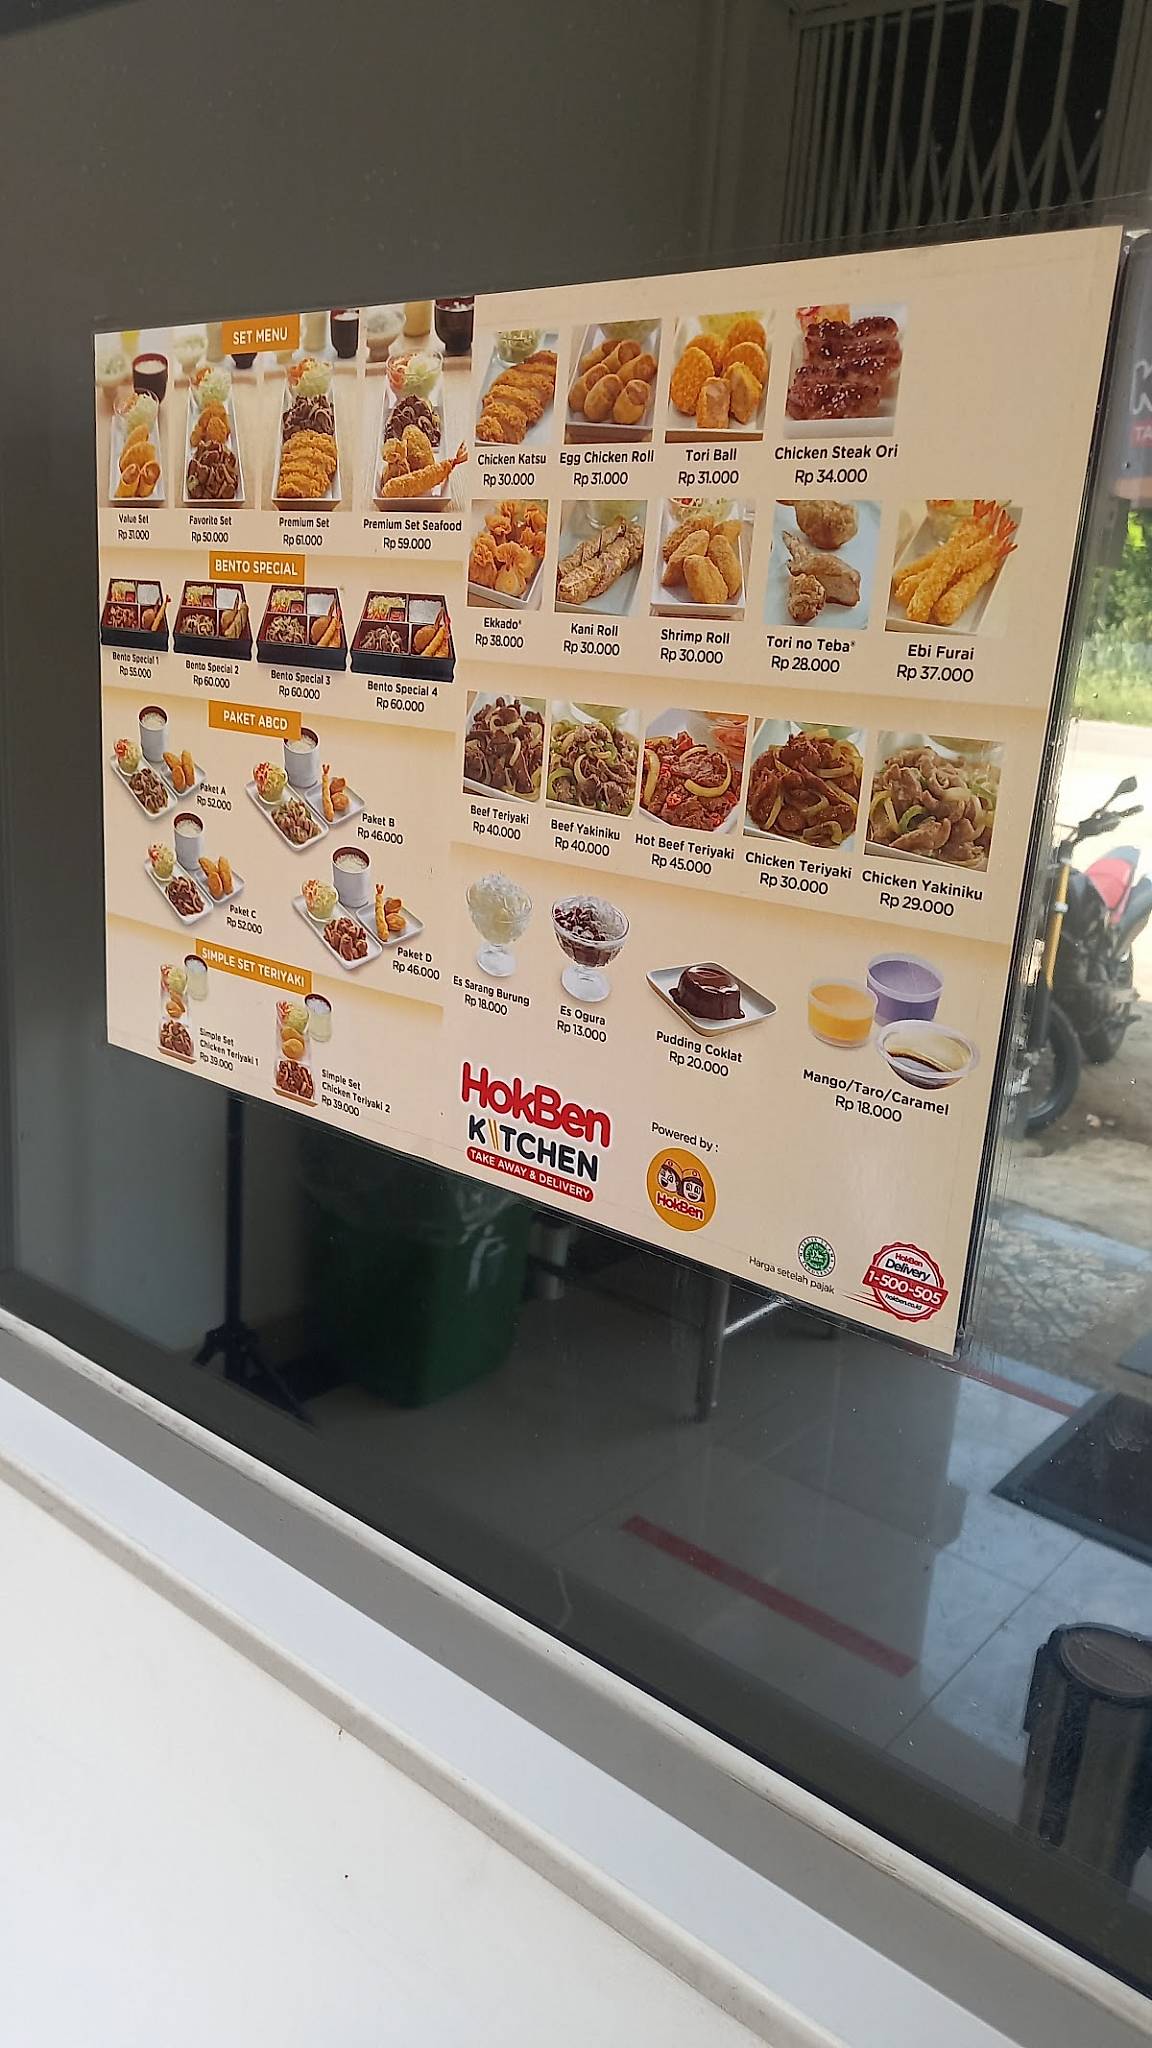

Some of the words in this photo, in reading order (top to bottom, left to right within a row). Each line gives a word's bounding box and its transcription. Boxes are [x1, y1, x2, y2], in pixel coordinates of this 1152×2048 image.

[232, 330, 252, 344] SET
[255, 327, 287, 342] MENU
[477, 453, 515, 465] Chicken
[518, 453, 546, 464] Katsu
[559, 452, 580, 465] Egg
[584, 450, 627, 463] Chicken
[631, 449, 654, 462] Roll
[685, 448, 710, 461] Tori
[713, 447, 736, 461] Ball
[774, 446, 828, 459] Chicken
[831, 444, 871, 458] Steak
[875, 443, 898, 458] Ori
[483, 473, 496, 488] Rp
[497, 472, 534, 485] 30.000
[573, 472, 589, 487] Rp
[590, 471, 628, 484] 31.000
[678, 470, 695, 486] Rp
[697, 470, 739, 484] 31.000
[794, 469, 813, 486] Rp
[816, 468, 867, 483] 34.000
[189, 514, 218, 525] Favorite
[219, 515, 232, 525] Set
[279, 516, 313, 527] Premium
[316, 517, 329, 527] Set
[363, 518, 402, 529] Premium
[404, 519, 420, 530] Set
[422, 519, 461, 531] Seafood
[191, 531, 201, 543] Rp
[202, 531, 228, 542] 50.000
[282, 534, 294, 547] Rp
[295, 534, 322, 546] 61.000
[383, 537, 396, 550] Rp
[397, 537, 431, 550] 59.000
[215, 559, 250, 573] BENTO
[252, 560, 297, 575] SPECIAL
[570, 622, 594, 635] Kani
[596, 624, 618, 636] Roll
[660, 628, 702, 644] Shrimp
[706, 631, 729, 644] Roll
[475, 633, 488, 647] Rp
[489, 634, 523, 648] 38.000
[563, 639, 578, 654] Rp
[580, 640, 620, 656] 30.000
[766, 635, 792, 648] Tori
[795, 639, 812, 650] no
[660, 647, 676, 663] Rp
[678, 648, 723, 664] 30.000
[907, 643, 932, 657] Ebi
[936, 645, 974, 660] Furai
[185, 659, 206, 670] Bento
[207, 662, 232, 673] Special
[771, 655, 789, 671] Rp
[791, 656, 840, 672] 28.000
[193, 674, 203, 686] Rp
[203, 675, 230, 688] 60.000
[270, 669, 293, 680] Bento
[295, 672, 323, 684] Special
[325, 675, 330, 685] 3
[896, 664, 917, 681] Rp
[919, 665, 973, 683] 37.000
[278, 684, 289, 698] Rp
[290, 686, 320, 700] 60.000
[367, 680, 393, 692] Bento
[395, 683, 428, 696] Special
[431, 686, 437, 696] 4
[376, 696, 389, 710] Rp
[390, 698, 424, 712] 60.000
[223, 710, 255, 725] PAKET
[258, 715, 287, 730] ABCD
[199, 782, 218, 794] Paket
[220, 786, 226, 795] A
[196, 795, 206, 806] Rp
[207, 797, 231, 811] 52.000
[362, 812, 385, 826] Paket
[388, 817, 394, 827] B
[470, 804, 490, 817] Beef
[492, 808, 529, 824] Teriyaki
[357, 826, 369, 840] Rp
[370, 829, 403, 844] 46.000
[472, 820, 485, 834] Rp
[486, 823, 520, 840] 40.000
[550, 818, 574, 832] Beef
[576, 823, 620, 840] Yakiniku
[554, 836, 569, 850] Rp
[570, 839, 609, 856] 40.000
[635, 833, 655, 846] Hot
[658, 837, 685, 851] Beef
[687, 841, 734, 859] Teriyaki
[651, 853, 667, 868] Rp
[669, 856, 711, 874] 45.000
[745, 851, 794, 869] Chicken
[799, 859, 852, 879] Teriyaki
[759, 872, 777, 888] Rp
[779, 875, 828, 894] 30.000
[862, 870, 916, 889] Chicken
[921, 879, 982, 900] Yakiniku
[229, 904, 249, 917] Paket
[250, 910, 256, 918] C
[879, 892, 899, 908] Rp
[902, 895, 954, 916] 29.000
[226, 916, 236, 927] Rp
[237, 919, 262, 934] 52.000
[397, 946, 423, 960] Paket
[425, 952, 432, 962] D
[201, 948, 235, 967] SIMPLE
[237, 958, 255, 971] SET
[258, 963, 305, 987] TERIYAKI
[392, 959, 405, 973] Rp
[406, 963, 439, 980] 46.000
[453, 975, 462, 986] Es
[464, 978, 494, 997] Sarang
[496, 988, 529, 1007] Burung
[464, 993, 476, 1007] Rp
[477, 997, 507, 1015] 18.000
[560, 1005, 571, 1016] Es
[574, 1009, 605, 1025] Ogura
[557, 1019, 570, 1034] Rp
[572, 1023, 606, 1042] 13.000
[656, 1030, 701, 1053] Pudding
[705, 1044, 742, 1062] Coklat
[669, 1050, 684, 1065] Rp
[686, 1055, 728, 1076] 20.000
[321, 1068, 346, 1085] Simple
[348, 1078, 360, 1090] Set
[321, 1081, 350, 1098] Chicken
[352, 1092, 382, 1110] Teriyaki
[384, 1103, 390, 1113] 2
[803, 1068, 948, 1115] Mango/Taro/Caramel
[321, 1094, 332, 1106] Rp
[332, 1098, 359, 1116] 39.000
[462, 1061, 611, 1147] HokBen
[835, 1094, 854, 1111] Rp
[856, 1100, 902, 1122] 18.000
[651, 1122, 697, 1146] Powered
[699, 1135, 713, 1152] by
[470, 1149, 495, 1166] TAKE
[497, 1158, 527, 1176] AWAY
[529, 1170, 537, 1181] &
[539, 1172, 590, 1199] DELIVERY
[656, 1192, 704, 1220] HokBen
[749, 1255, 775, 1272] Harga
[777, 1267, 808, 1285] setelah
[809, 1280, 834, 1294] pajak
[885, 1258, 931, 1282] Delivery
[868, 1270, 943, 1305] 1-500-505
